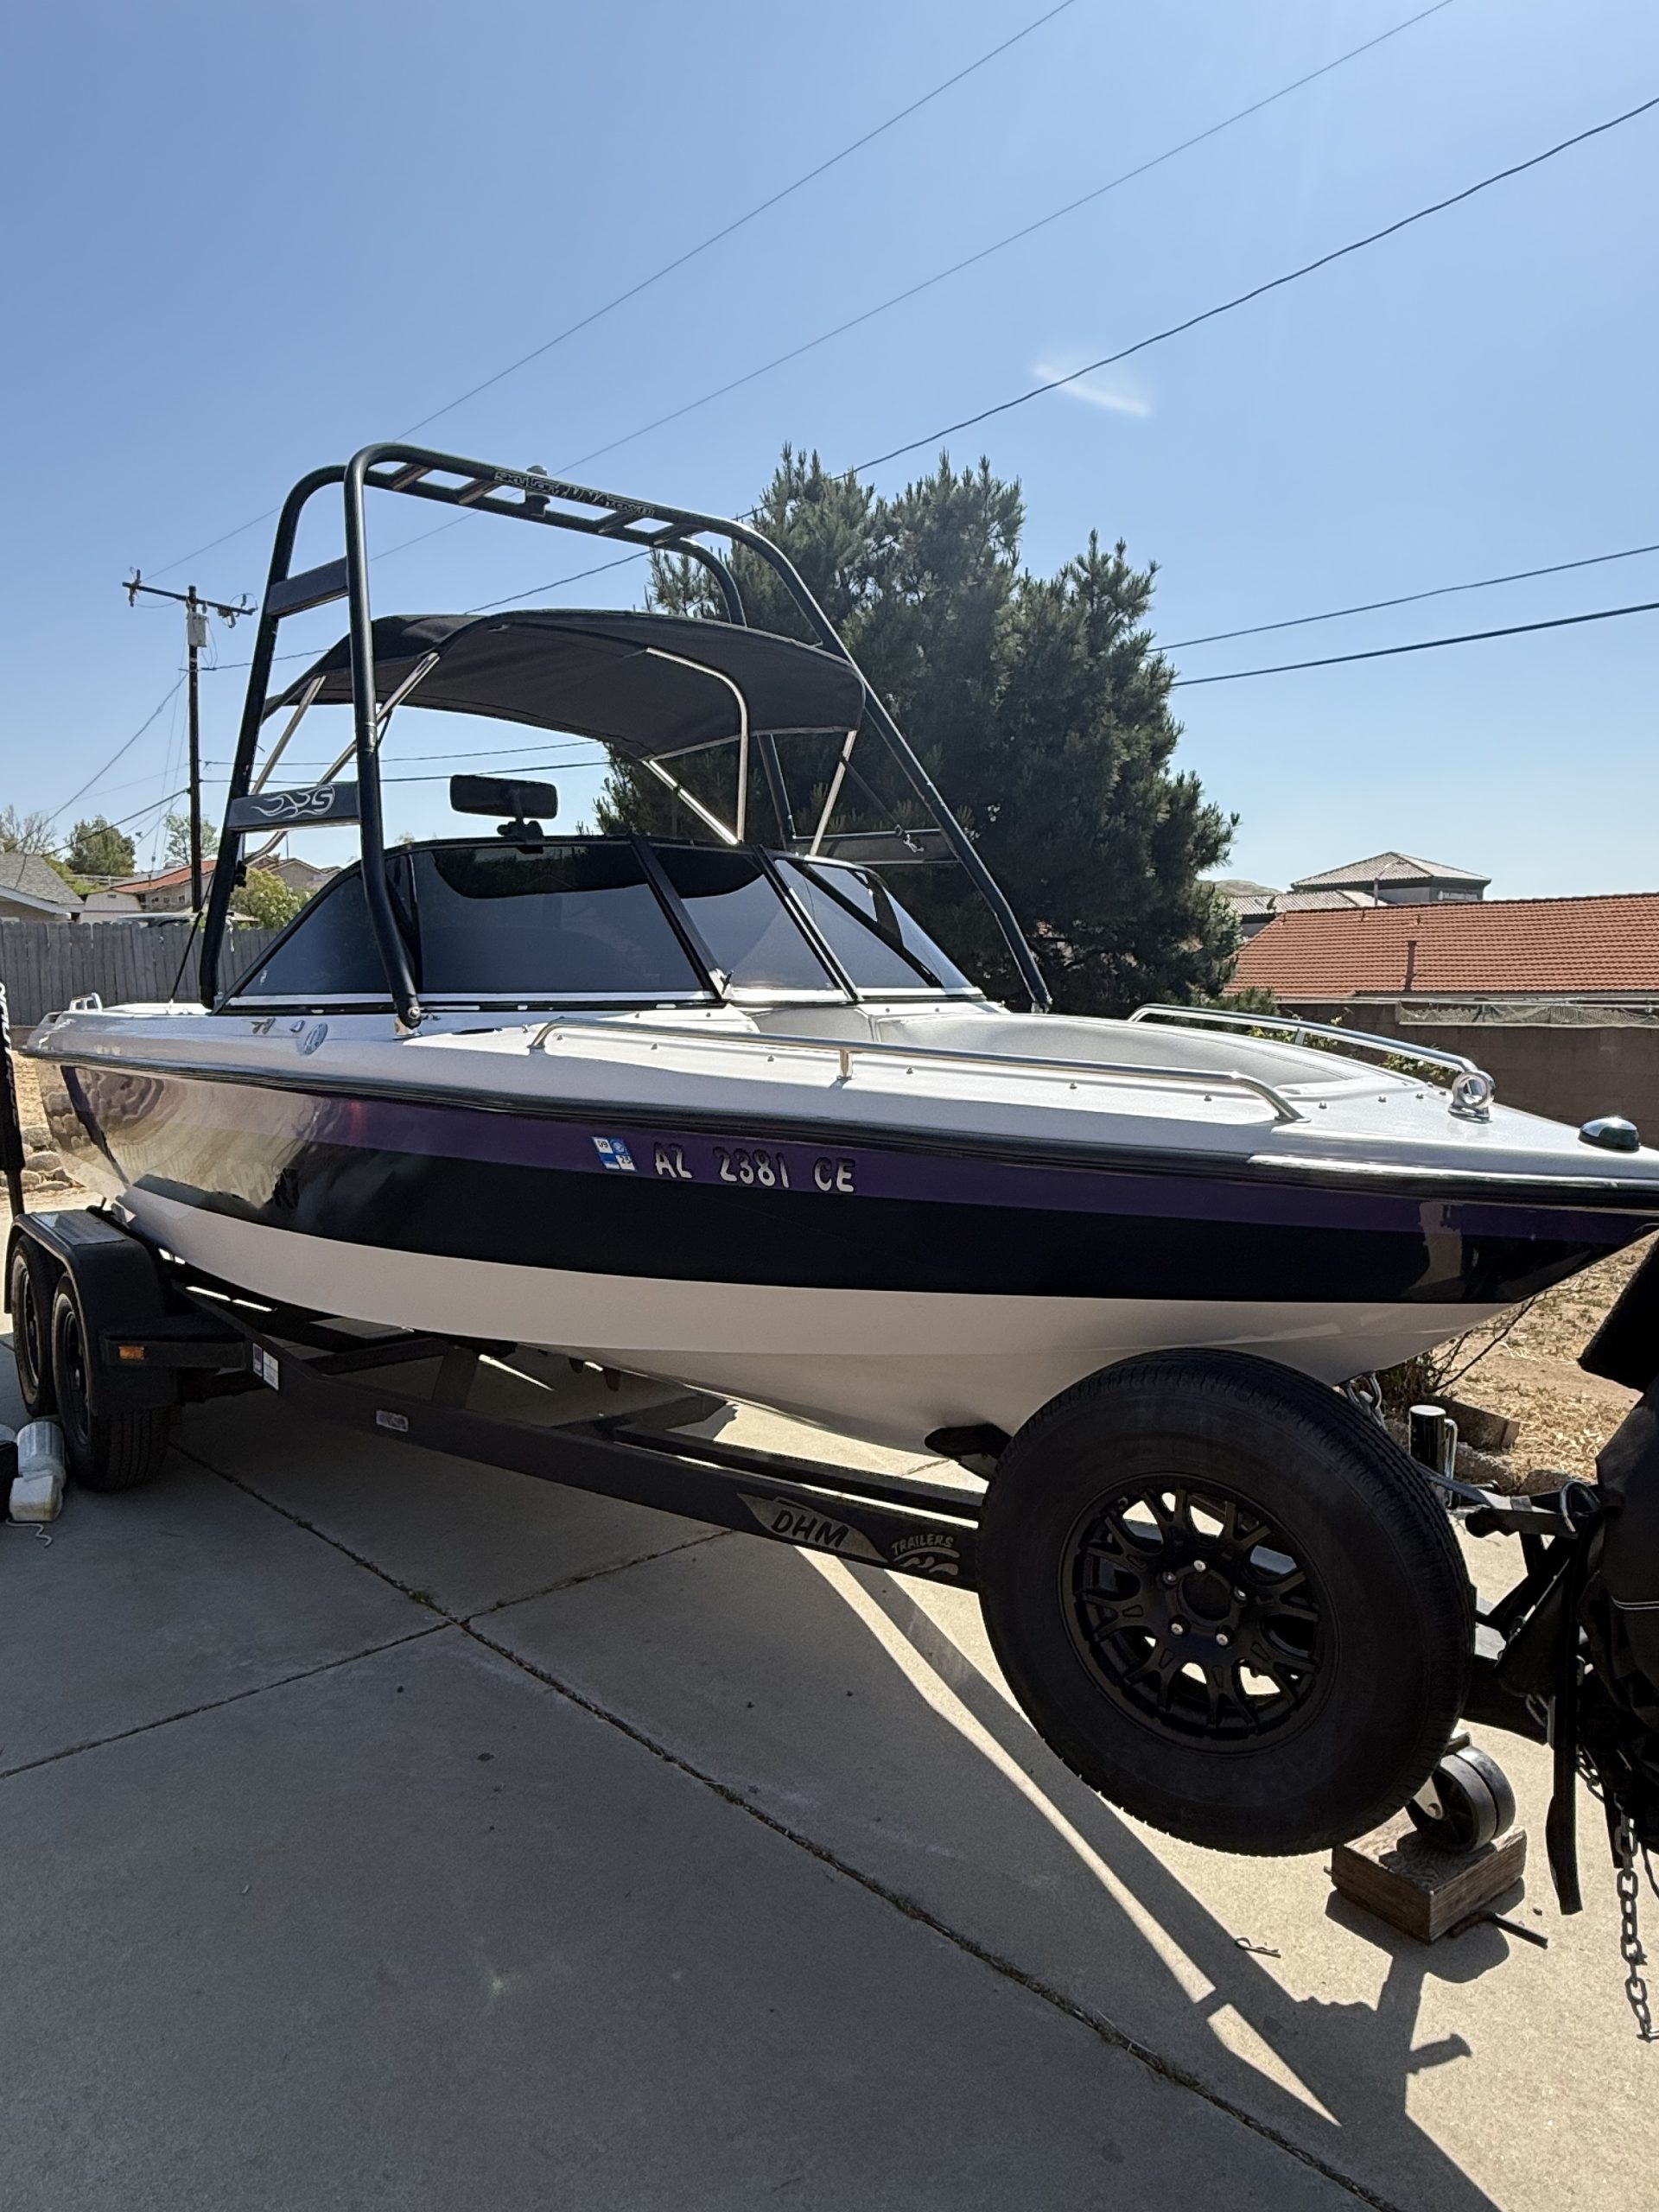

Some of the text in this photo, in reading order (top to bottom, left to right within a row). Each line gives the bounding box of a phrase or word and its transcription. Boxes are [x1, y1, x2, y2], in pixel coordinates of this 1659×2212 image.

[713, 1147, 789, 1188] 2381
[813, 1156, 855, 1192] CE
[771, 1510, 849, 1548] DHM
[891, 1533, 954, 1555] TRAILERS
